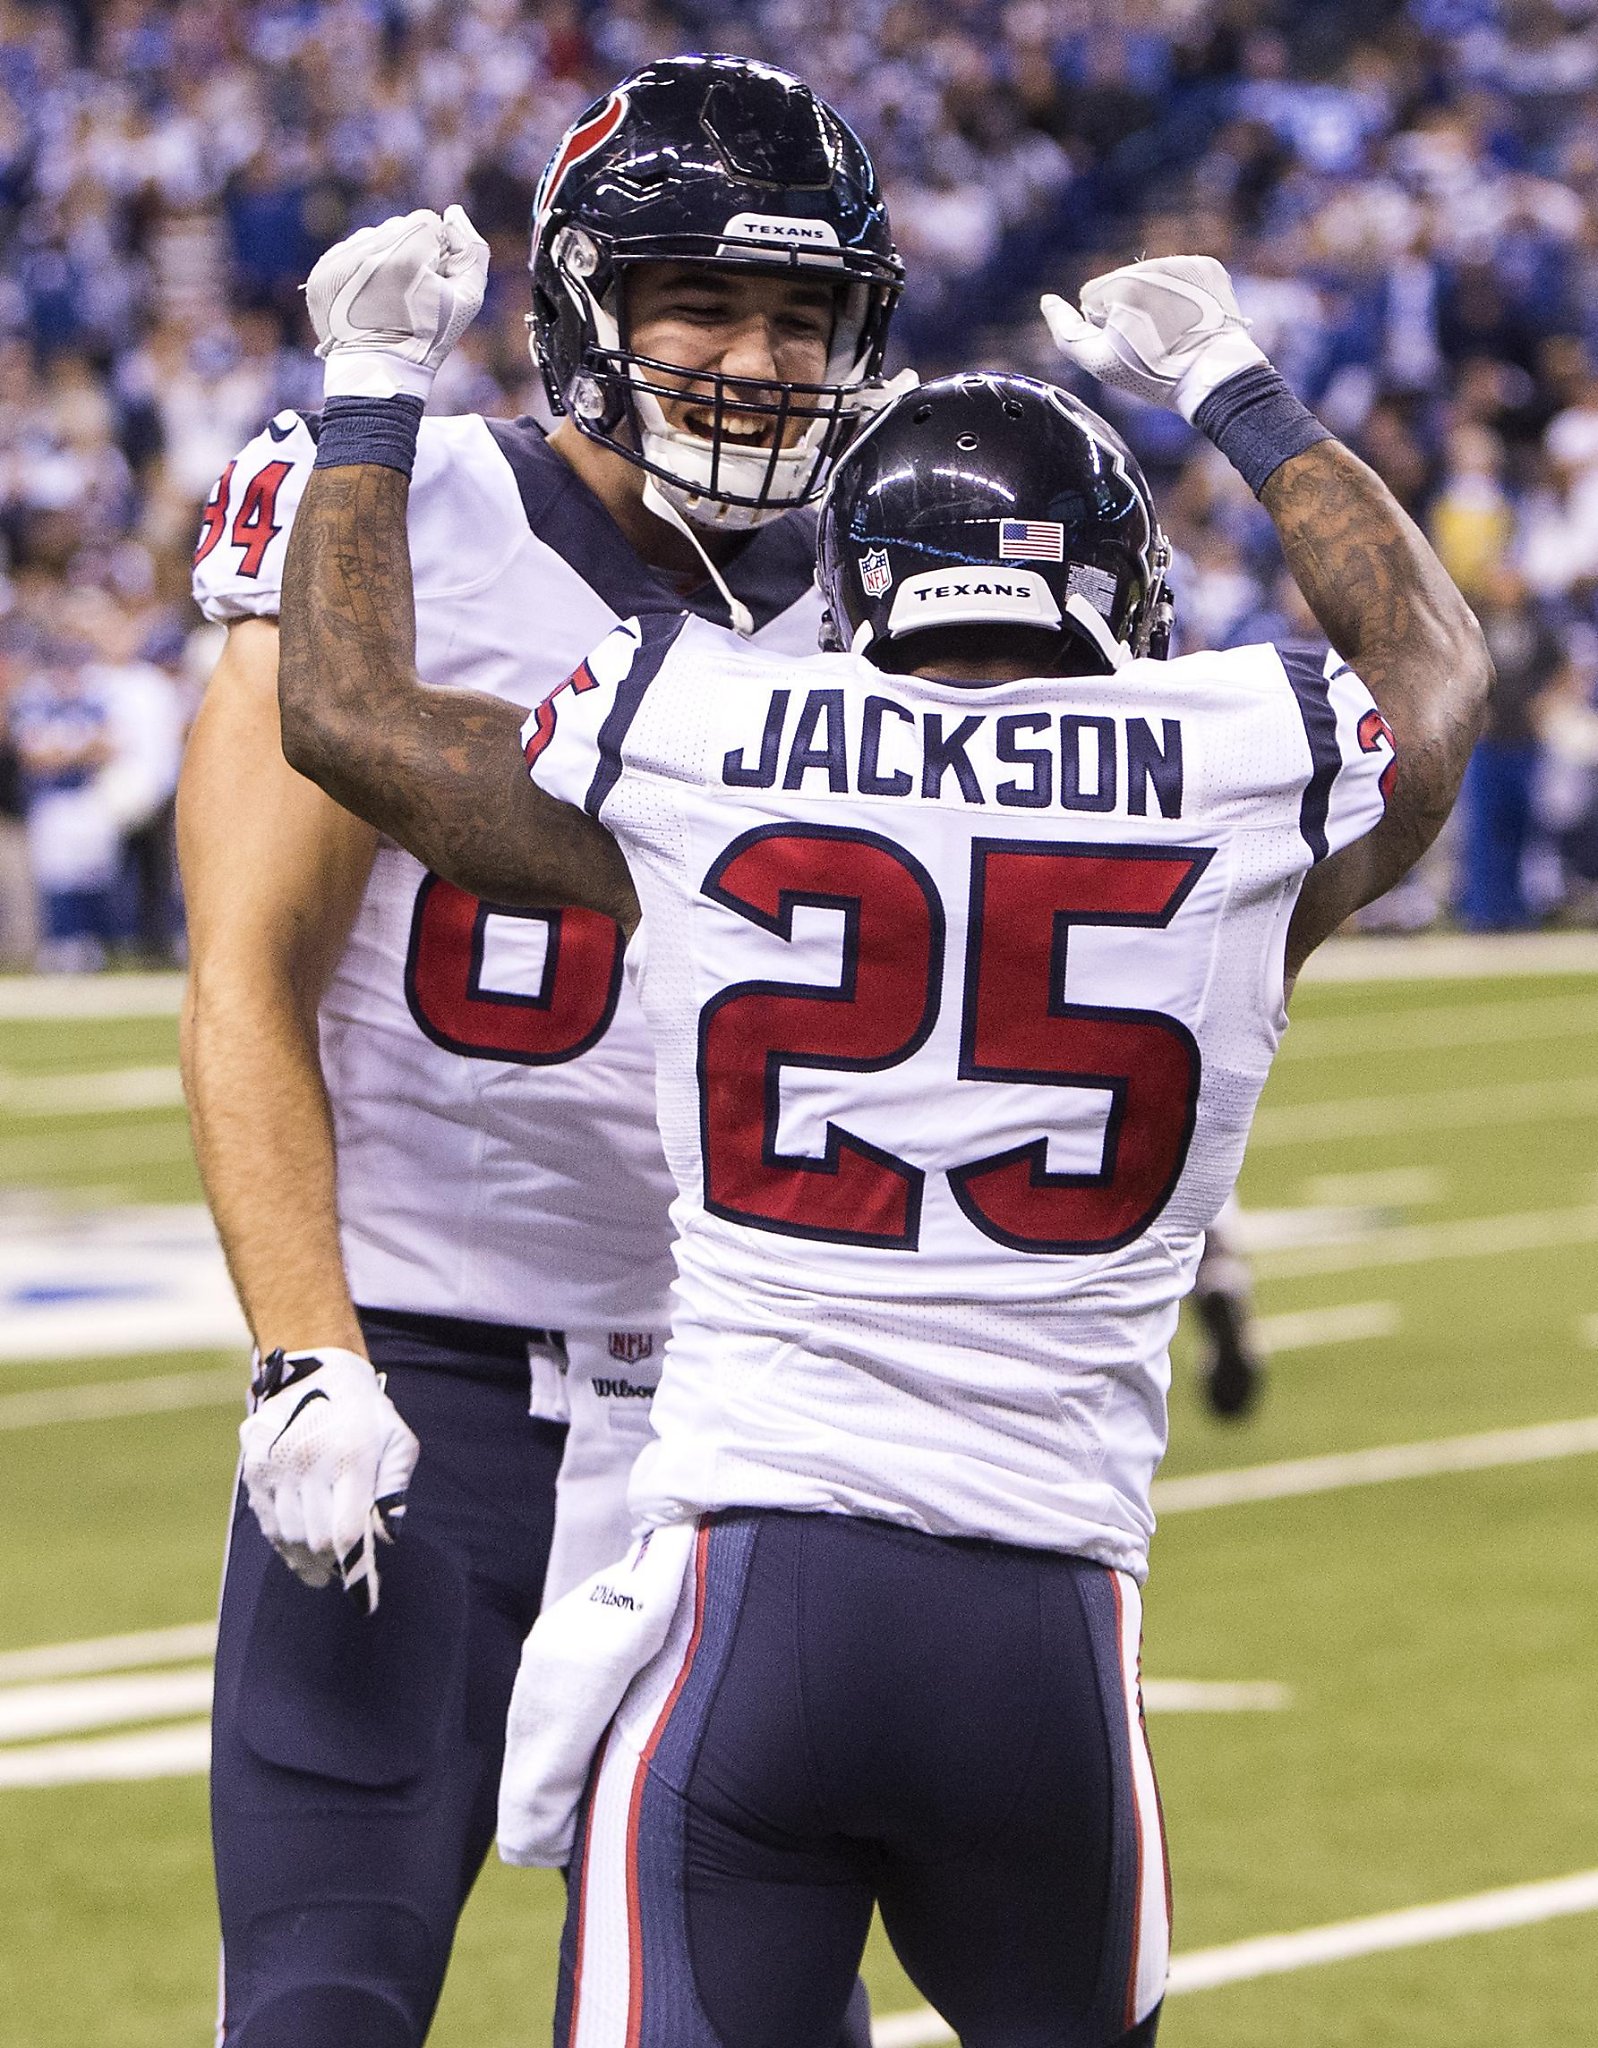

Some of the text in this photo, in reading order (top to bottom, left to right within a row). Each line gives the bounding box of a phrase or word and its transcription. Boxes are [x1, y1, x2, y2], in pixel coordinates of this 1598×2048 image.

[743, 223, 824, 239] TEXANS
[866, 568, 888, 590] NFL
[914, 584, 1032, 602] TEXANS
[722, 689, 1183, 819] JACKSON
[696, 821, 1217, 1255] 25
